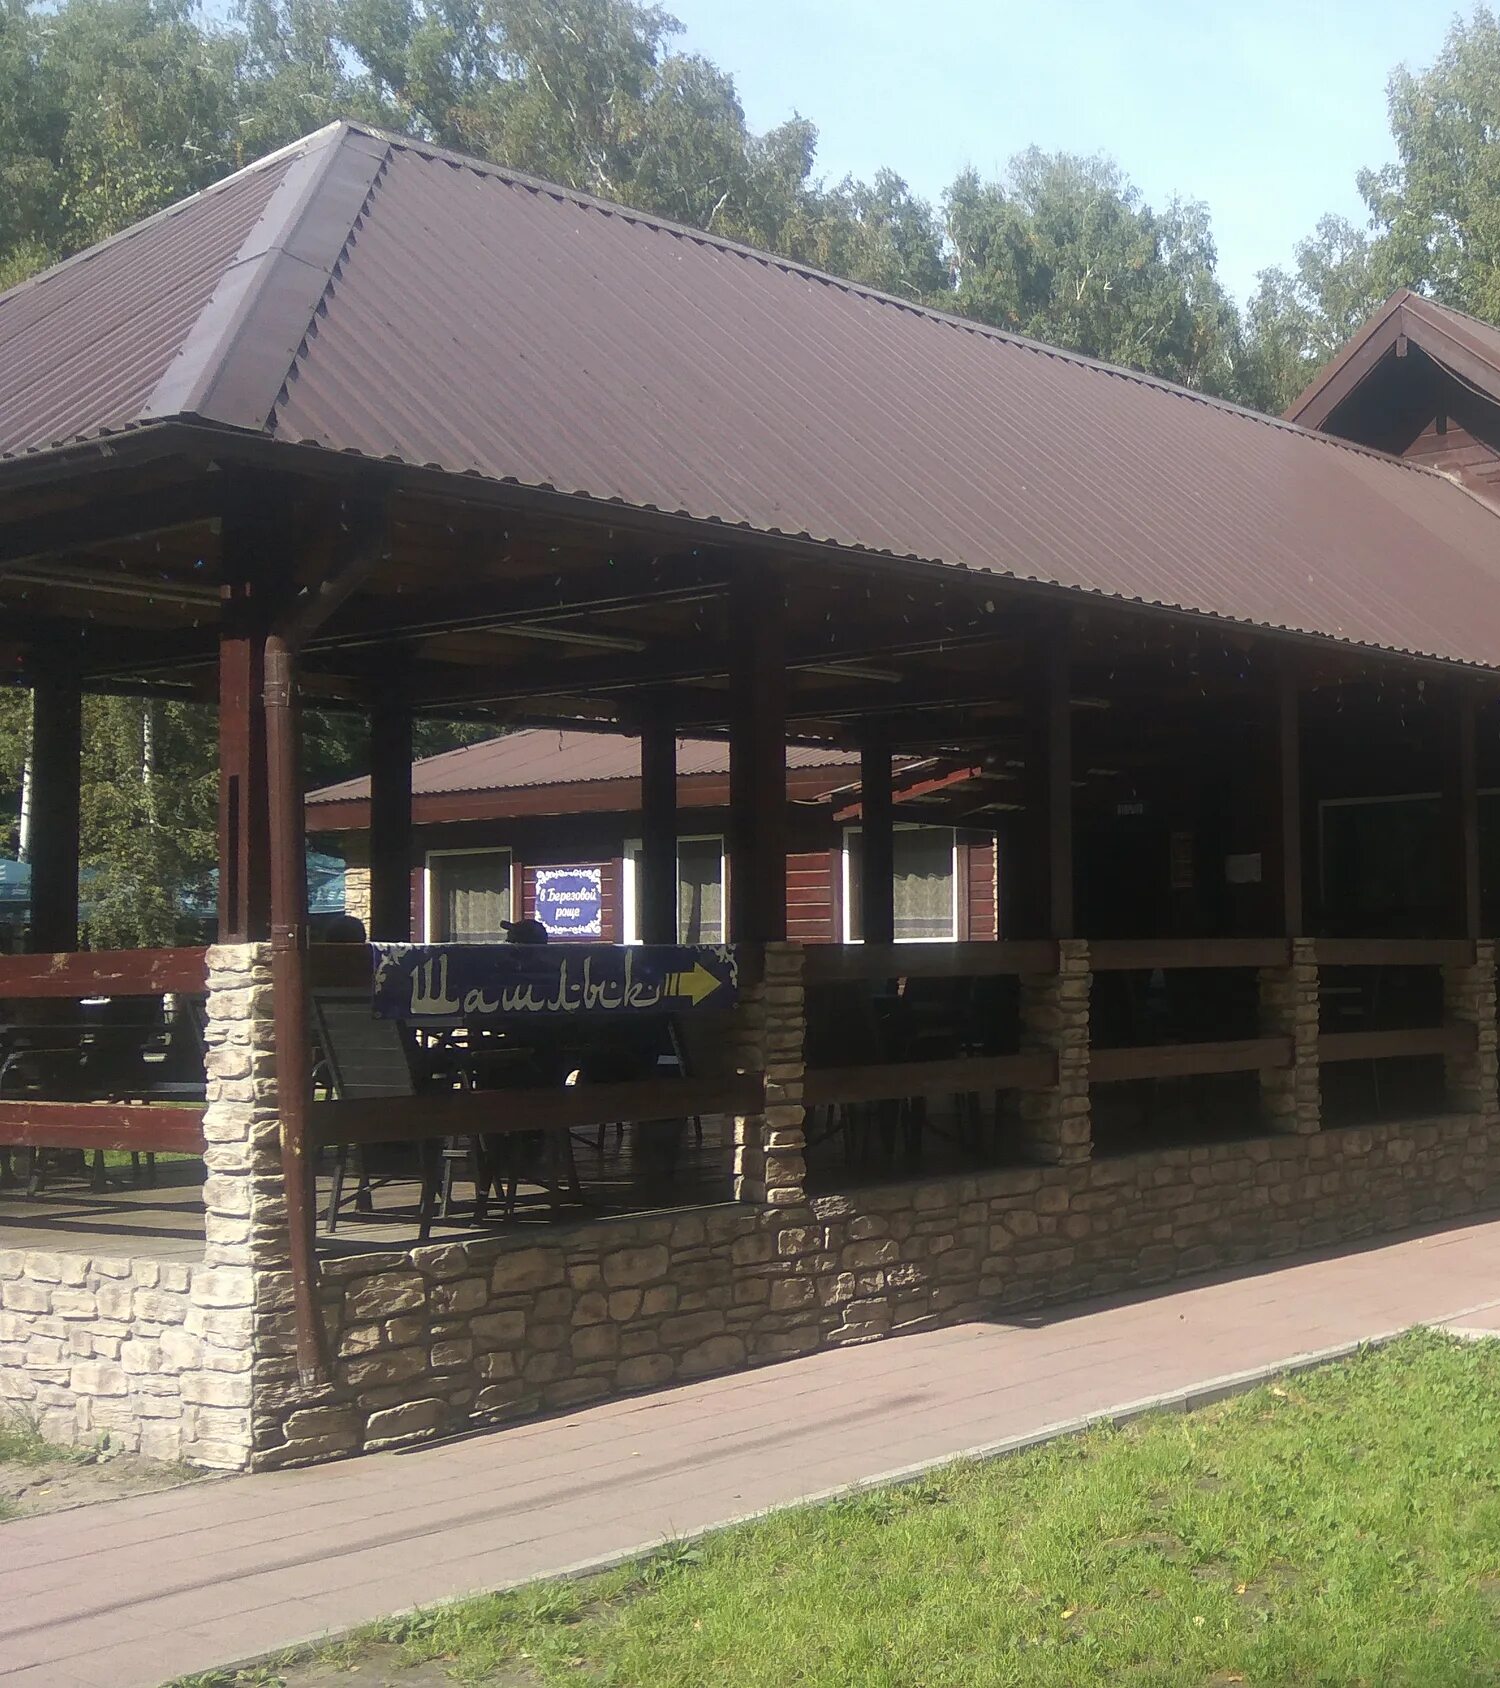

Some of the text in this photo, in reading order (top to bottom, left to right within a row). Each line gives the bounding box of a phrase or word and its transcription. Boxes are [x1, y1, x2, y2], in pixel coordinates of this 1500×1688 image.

[539, 886, 597, 905] в Березовой
[555, 907, 581, 921] роще
[409, 948, 661, 1015] Шашлык
